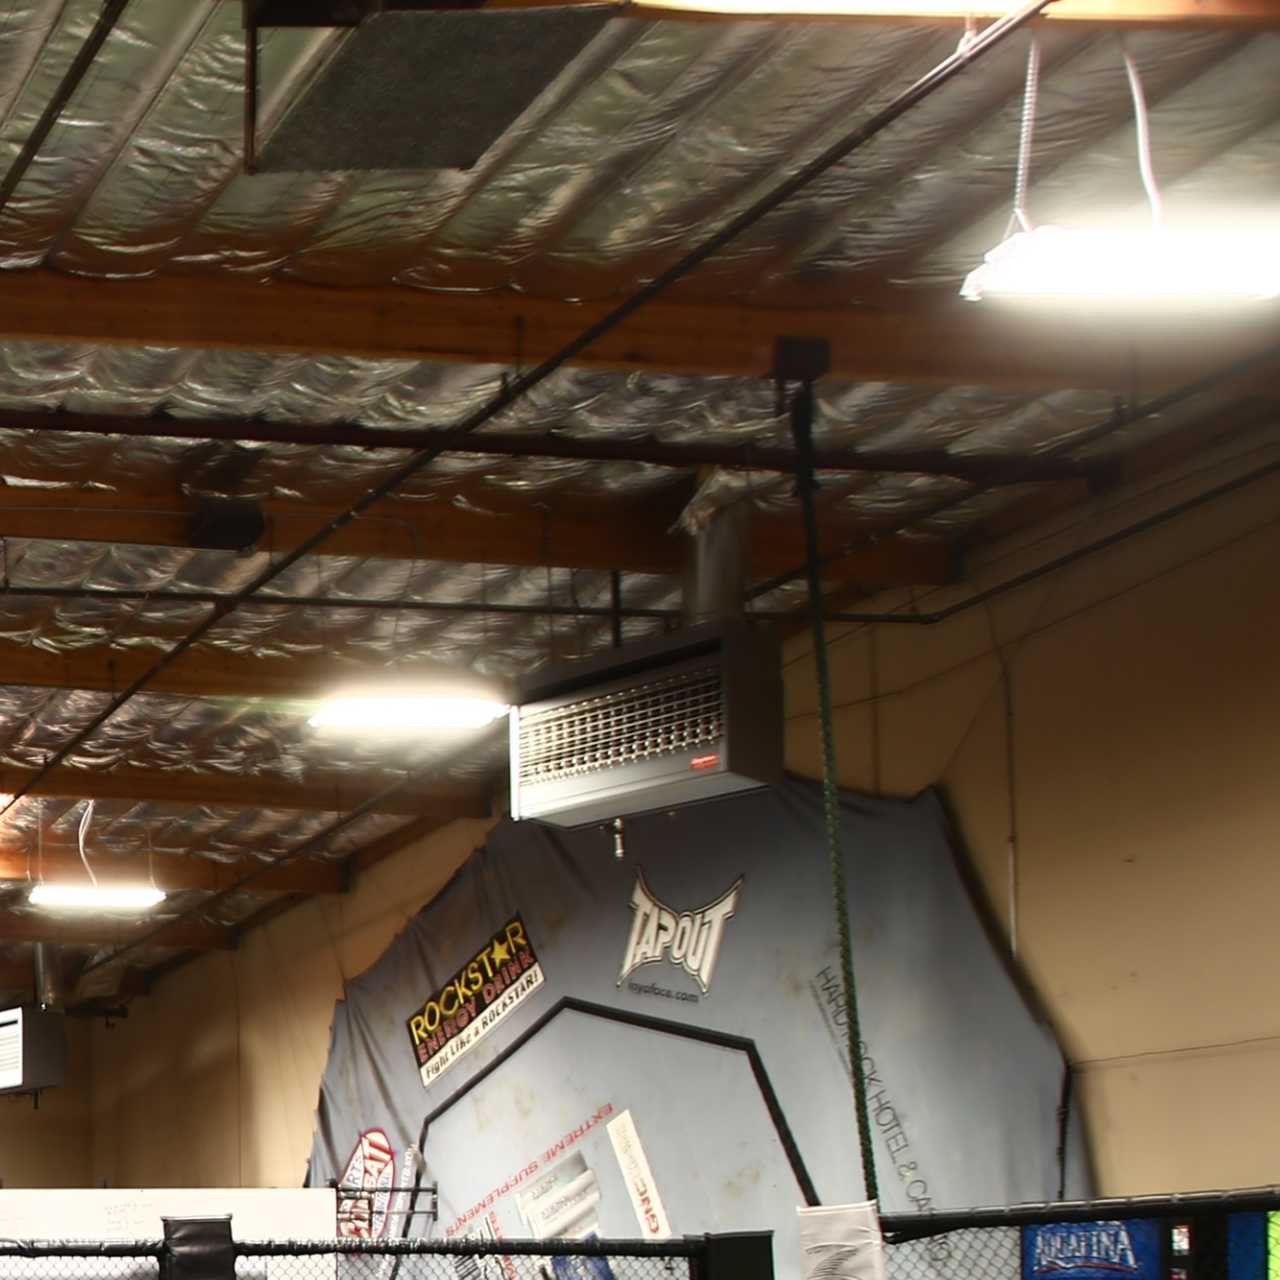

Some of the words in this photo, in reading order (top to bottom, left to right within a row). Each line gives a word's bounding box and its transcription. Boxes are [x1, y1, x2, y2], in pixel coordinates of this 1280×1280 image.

[482, 951, 534, 1003] DRINK
[543, 1102, 615, 1164] EXTREME
[869, 1090, 909, 1162] HOTEL
[898, 1161, 918, 1182] &
[445, 1161, 540, 1238] SUPPLEMENTS
